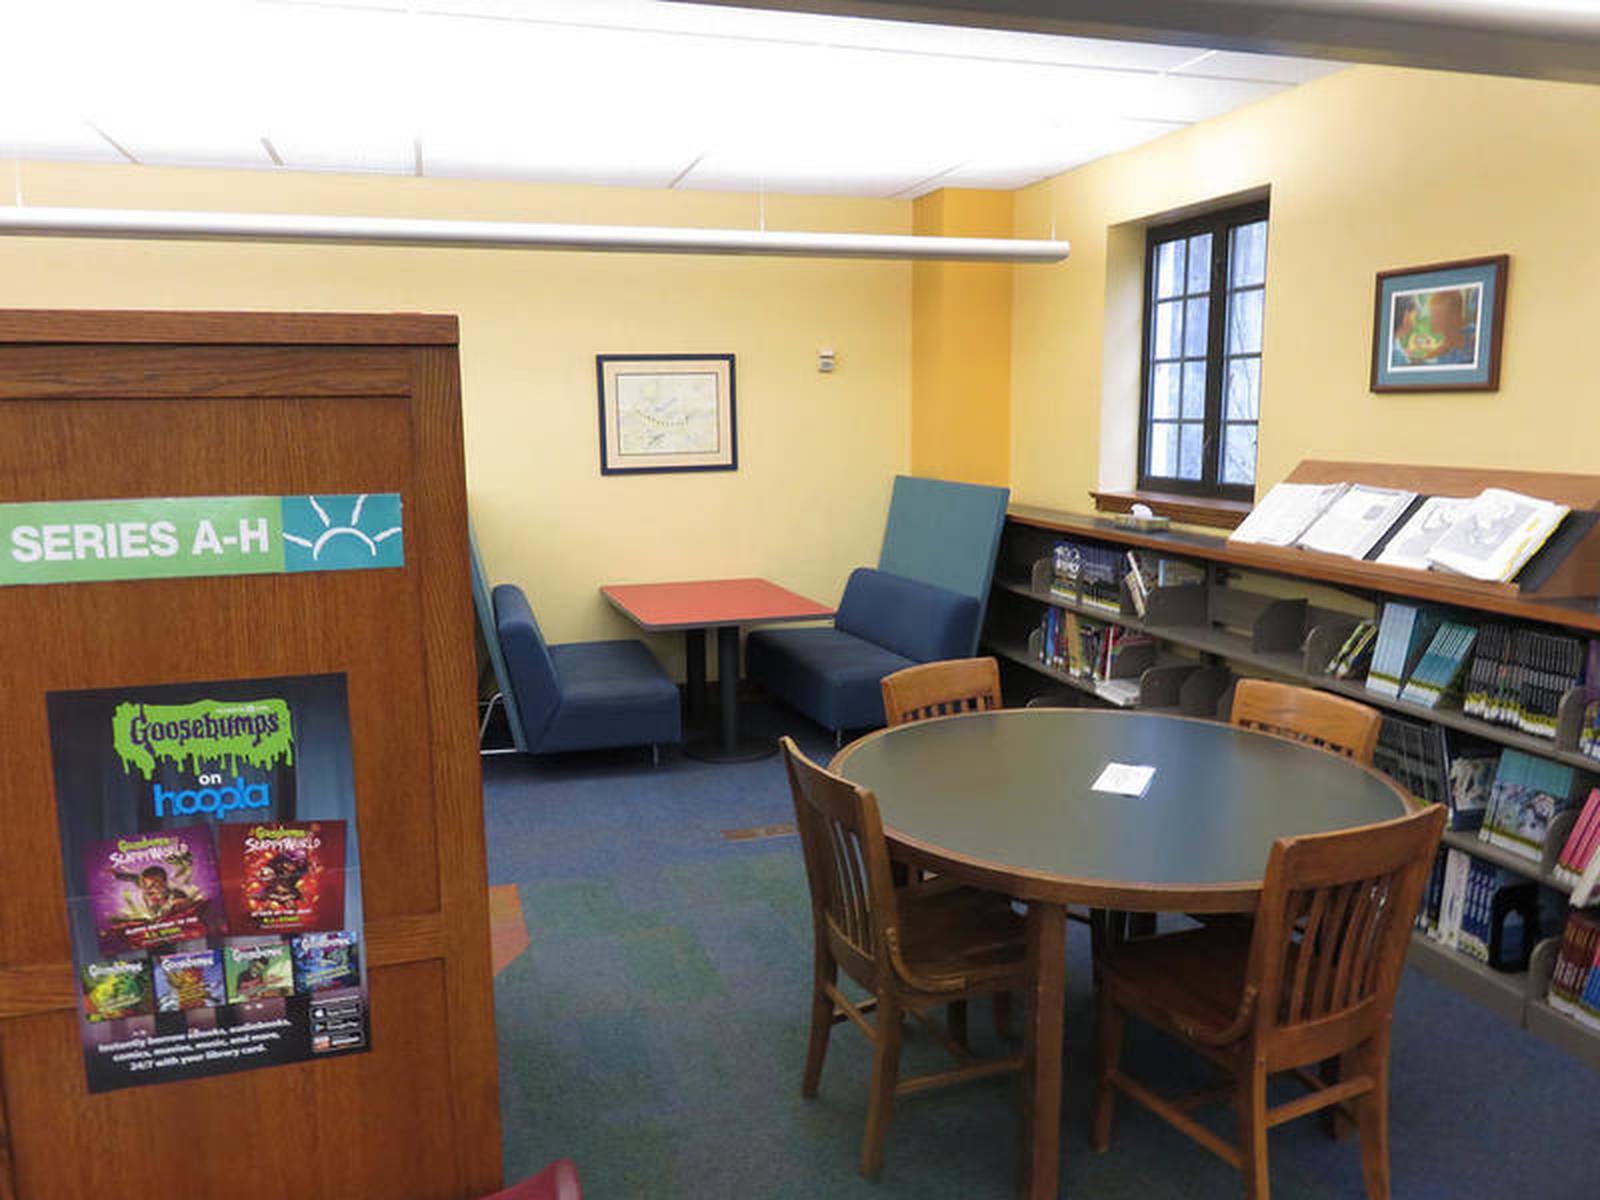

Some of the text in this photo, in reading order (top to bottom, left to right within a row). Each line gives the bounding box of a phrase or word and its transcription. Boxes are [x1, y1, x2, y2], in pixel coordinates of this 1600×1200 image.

[11, 518, 270, 563] SERIES A-H
[130, 705, 280, 751] Goosebumps
[153, 777, 270, 819] hoopla
[198, 772, 222, 786] on
